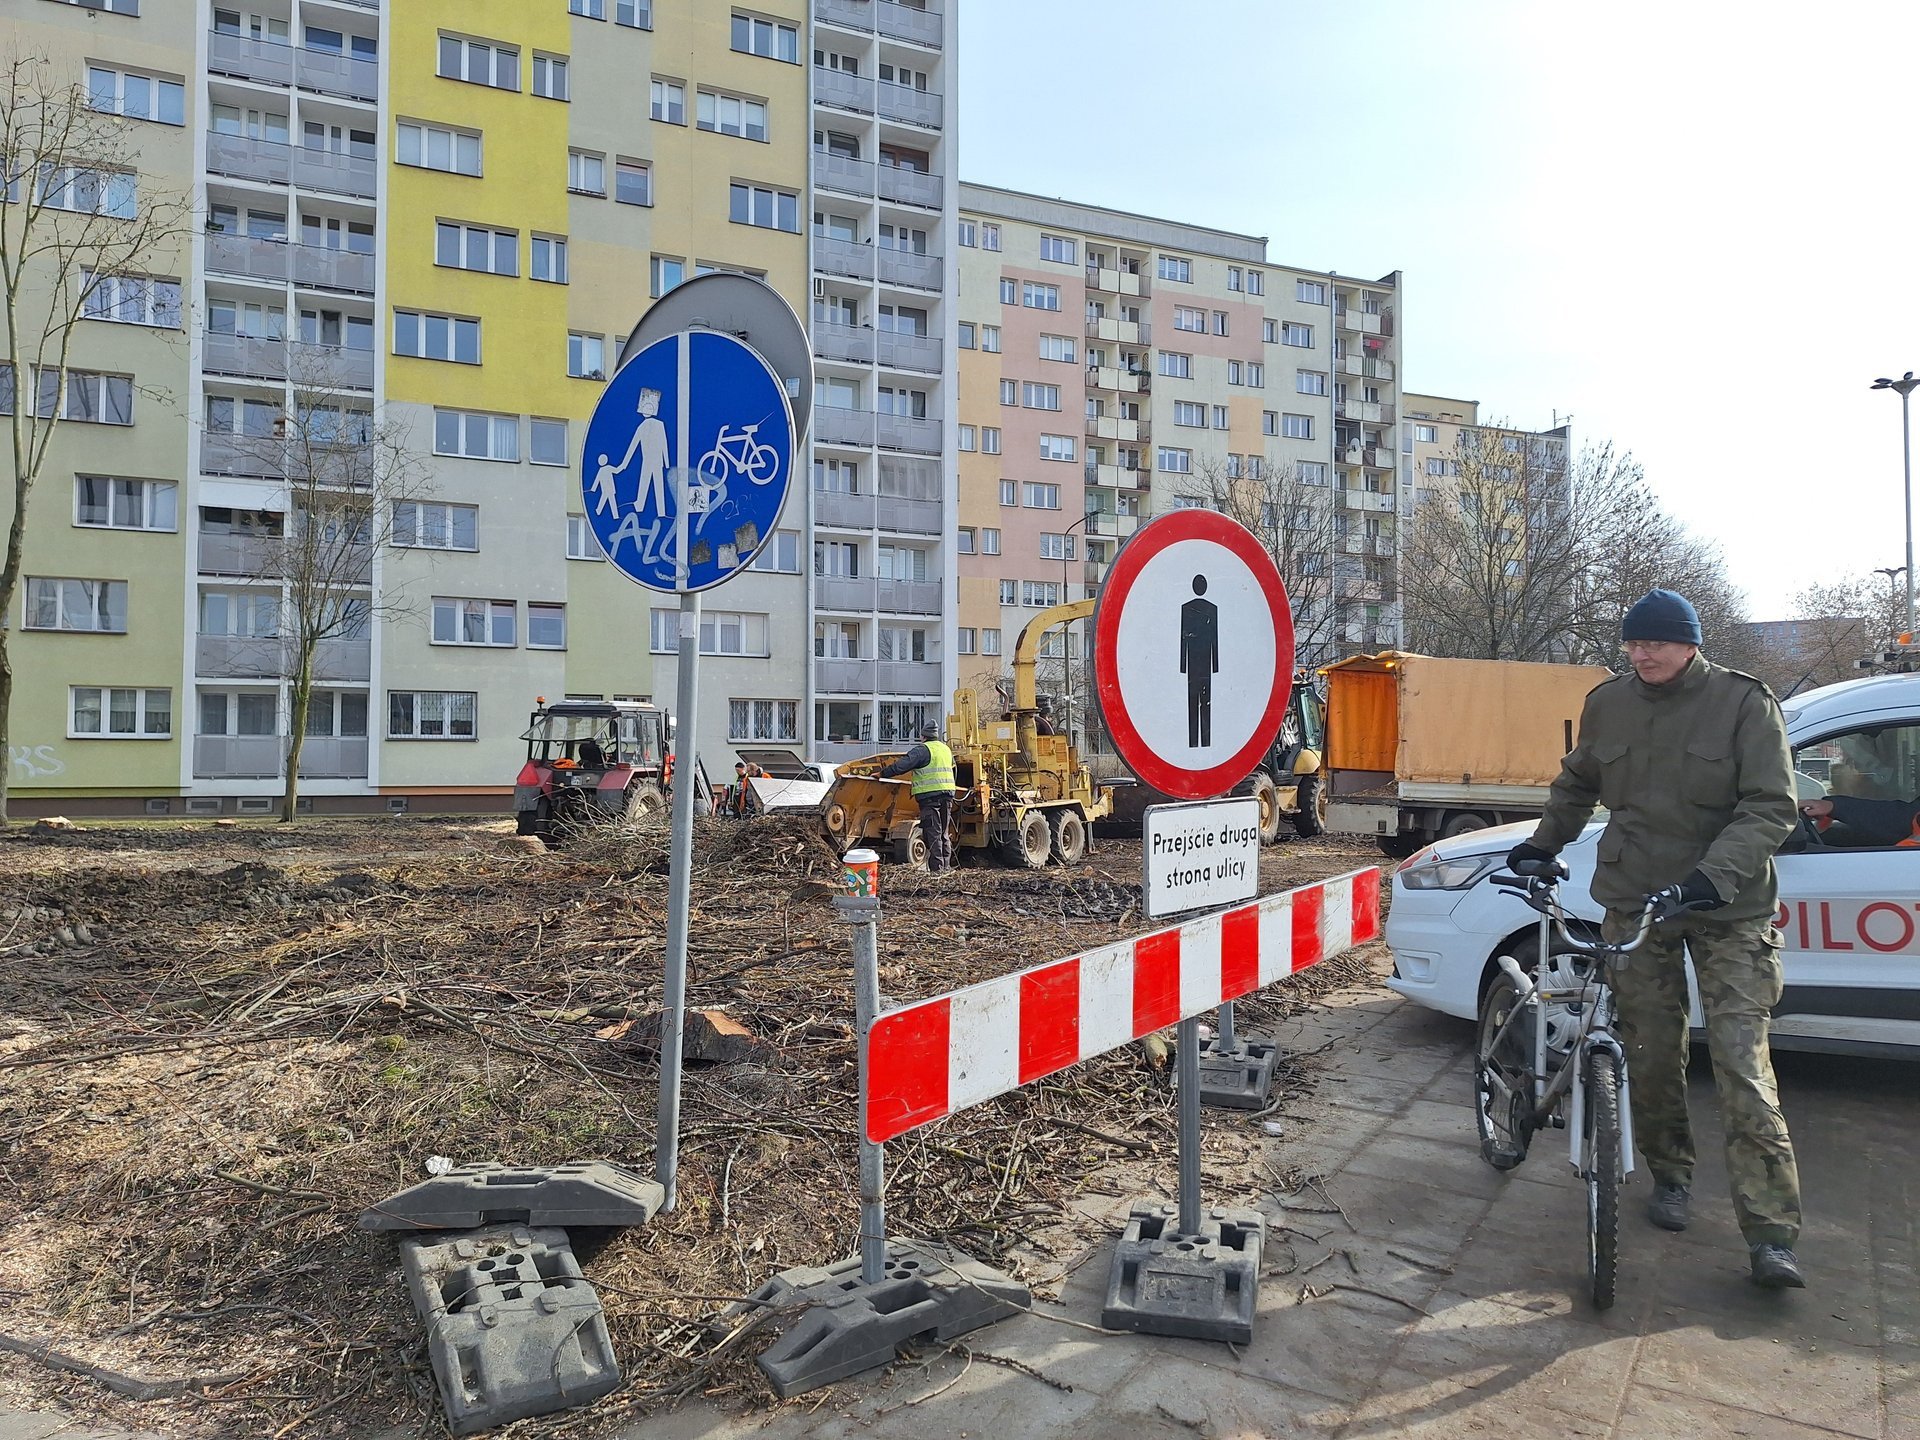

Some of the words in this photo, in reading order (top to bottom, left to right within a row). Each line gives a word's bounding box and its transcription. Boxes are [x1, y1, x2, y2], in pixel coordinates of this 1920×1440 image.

[1153, 827, 1214, 857] Przejście
[1216, 857, 1246, 881] ulicy
[1771, 901, 1920, 952] ILO
